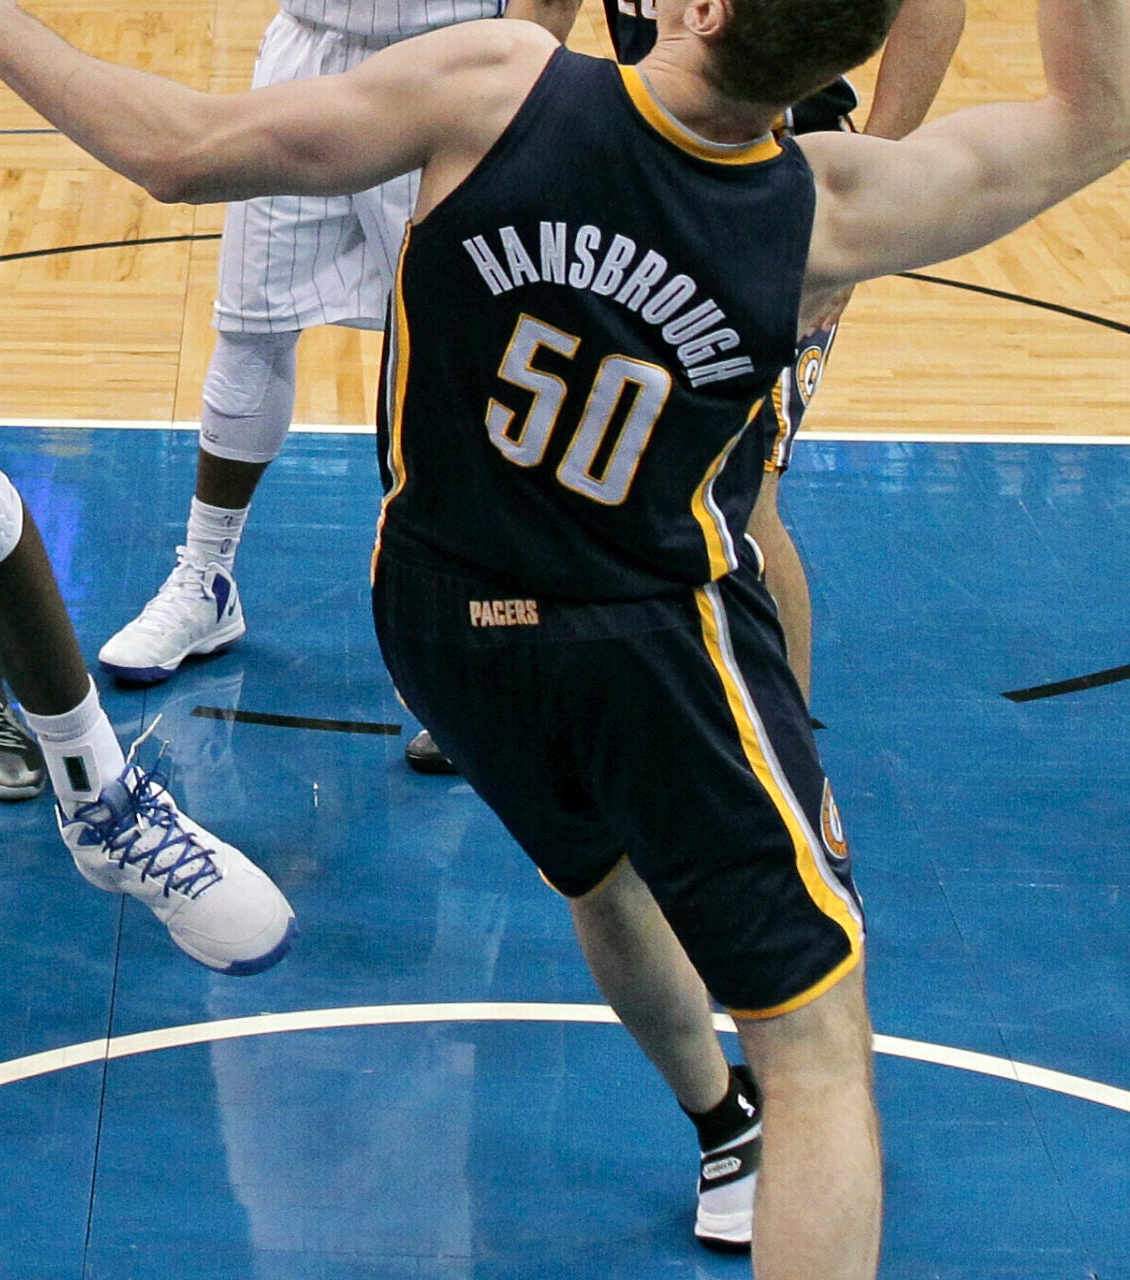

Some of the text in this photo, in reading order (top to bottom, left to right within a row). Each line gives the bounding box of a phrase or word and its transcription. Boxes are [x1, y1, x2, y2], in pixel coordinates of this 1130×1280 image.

[462, 220, 757, 388] HANSBROUGH
[485, 312, 672, 507] 50
[468, 598, 540, 628] PACERS
